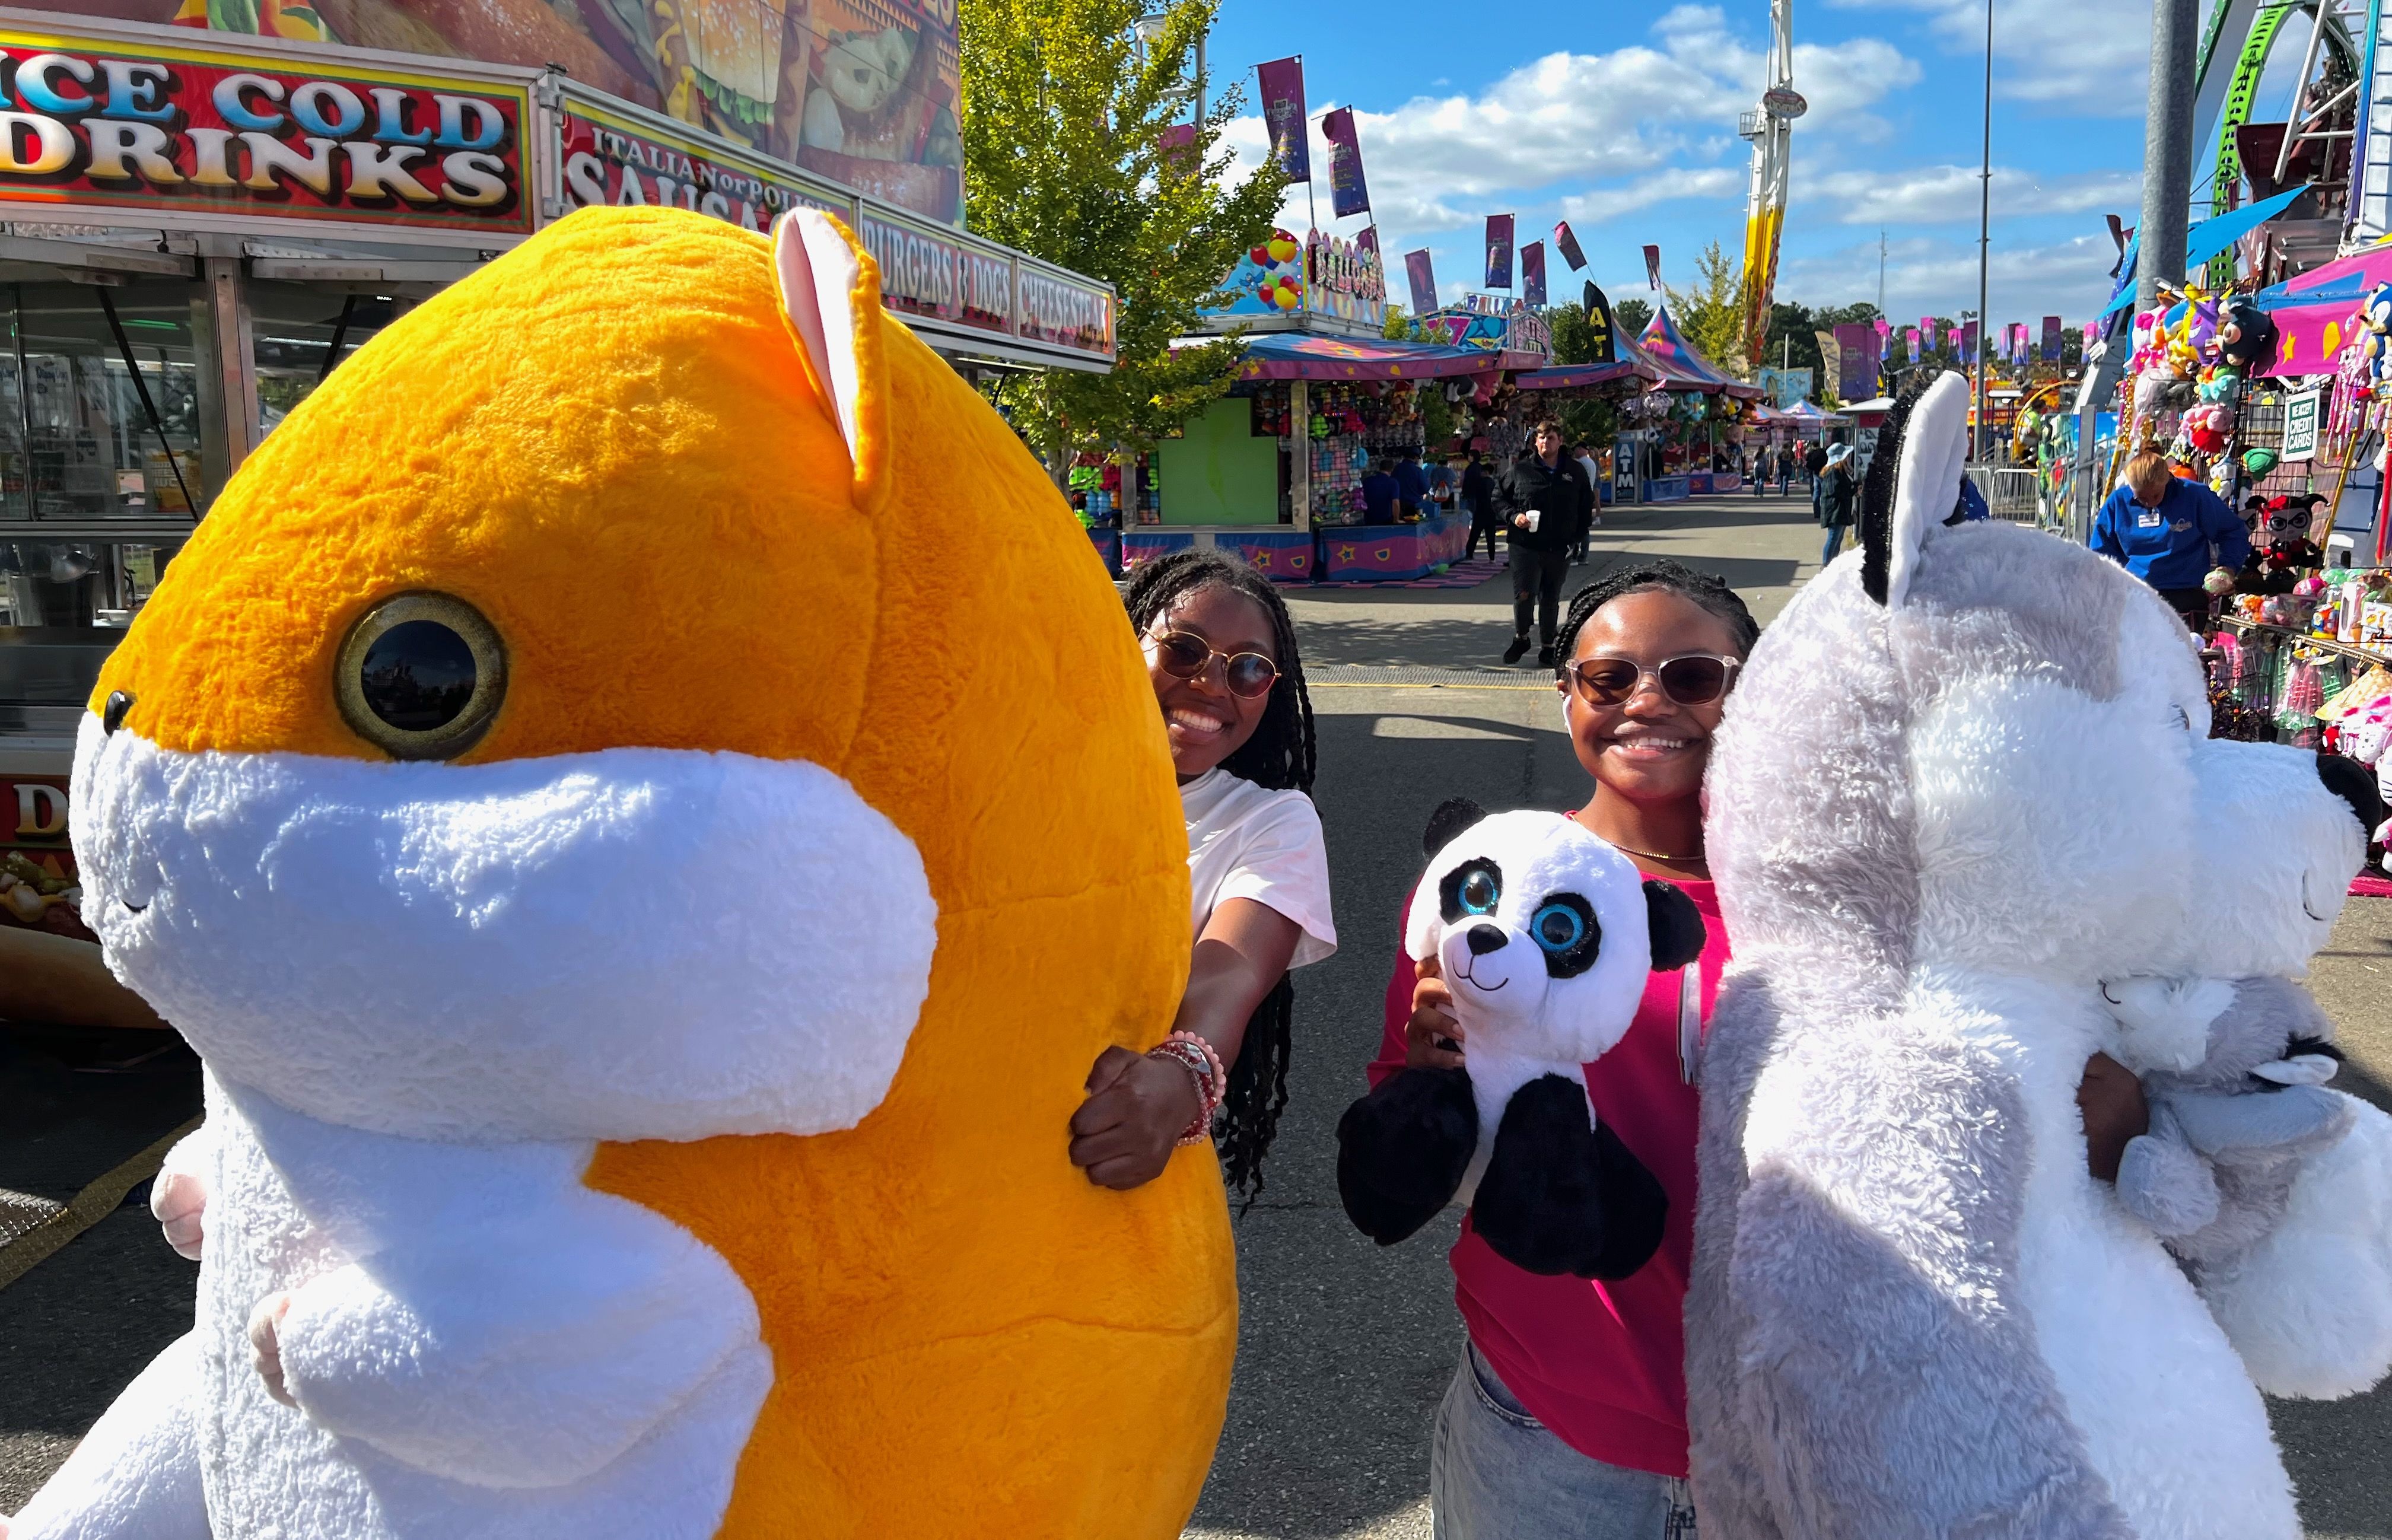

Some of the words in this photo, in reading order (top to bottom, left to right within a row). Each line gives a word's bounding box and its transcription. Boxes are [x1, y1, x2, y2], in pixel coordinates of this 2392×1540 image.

[212, 73, 505, 149] COLD
[0, 111, 508, 206] DRINKS
[592, 127, 717, 189] ITALIAN
[863, 219, 952, 304] BURGERS
[973, 255, 1010, 317] DOGS
[1315, 244, 1385, 301] BALLOONS
[1590, 307, 1607, 357] AT
[2288, 431, 2313, 450] CARDS
[2290, 415, 2314, 435] CREDIT
[1617, 443, 1634, 487] ATM
